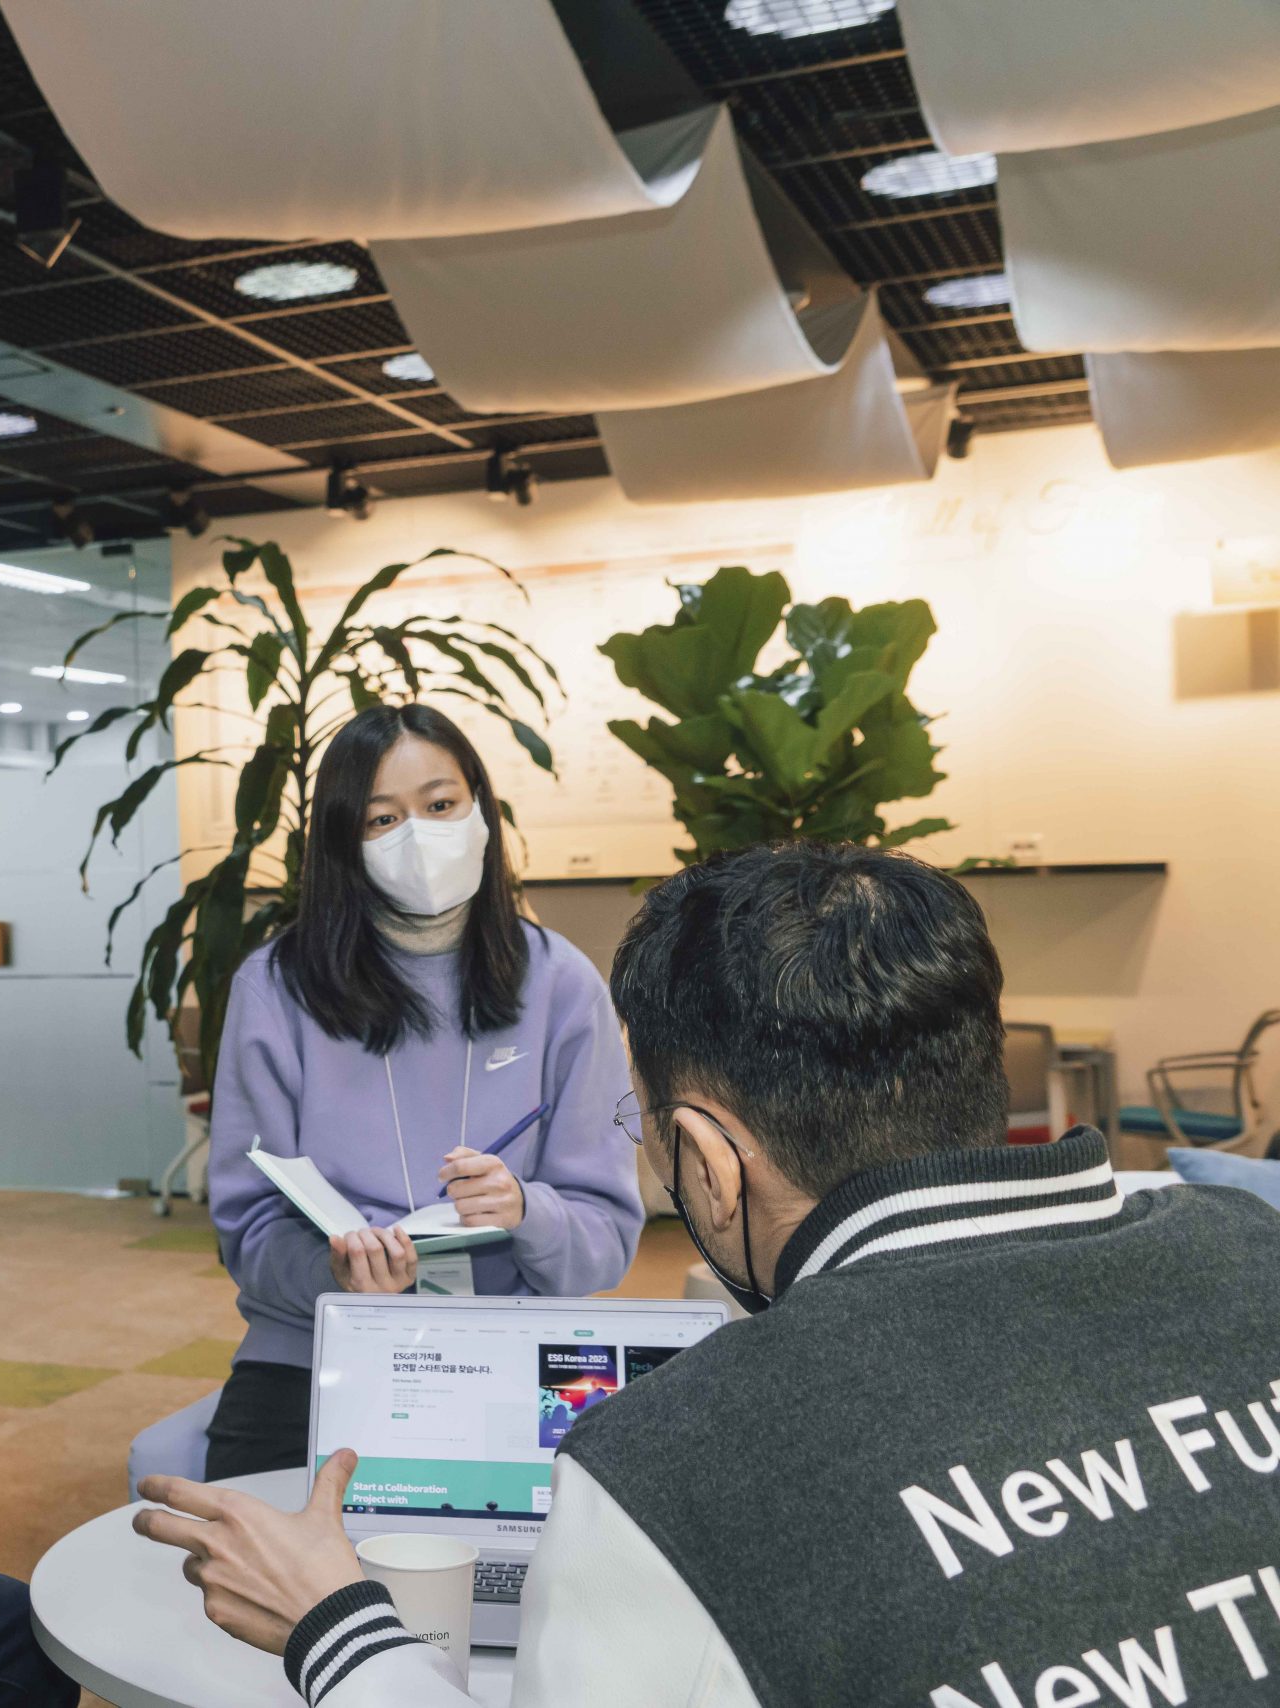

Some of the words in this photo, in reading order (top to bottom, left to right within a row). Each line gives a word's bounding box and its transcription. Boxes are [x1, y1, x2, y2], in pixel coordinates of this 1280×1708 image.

[393, 1352, 418, 1361] ESG의
[419, 1352, 442, 1362] 가치를
[547, 1353, 563, 1362] ESG
[564, 1353, 587, 1363] Korea
[588, 1354, 608, 1364] 2023
[418, 1364, 457, 1374] 스타트업을
[458, 1365, 493, 1375] 찾습니다.
[353, 1482, 376, 1492] Start
[377, 1484, 384, 1492] a
[385, 1483, 448, 1495] Collaboration
[352, 1494, 386, 1505] Project
[386, 1495, 408, 1505] with
[898, 1438, 1149, 1579] New
[496, 1524, 543, 1533] SAMSUNG
[1186, 1565, 1280, 1681] T
